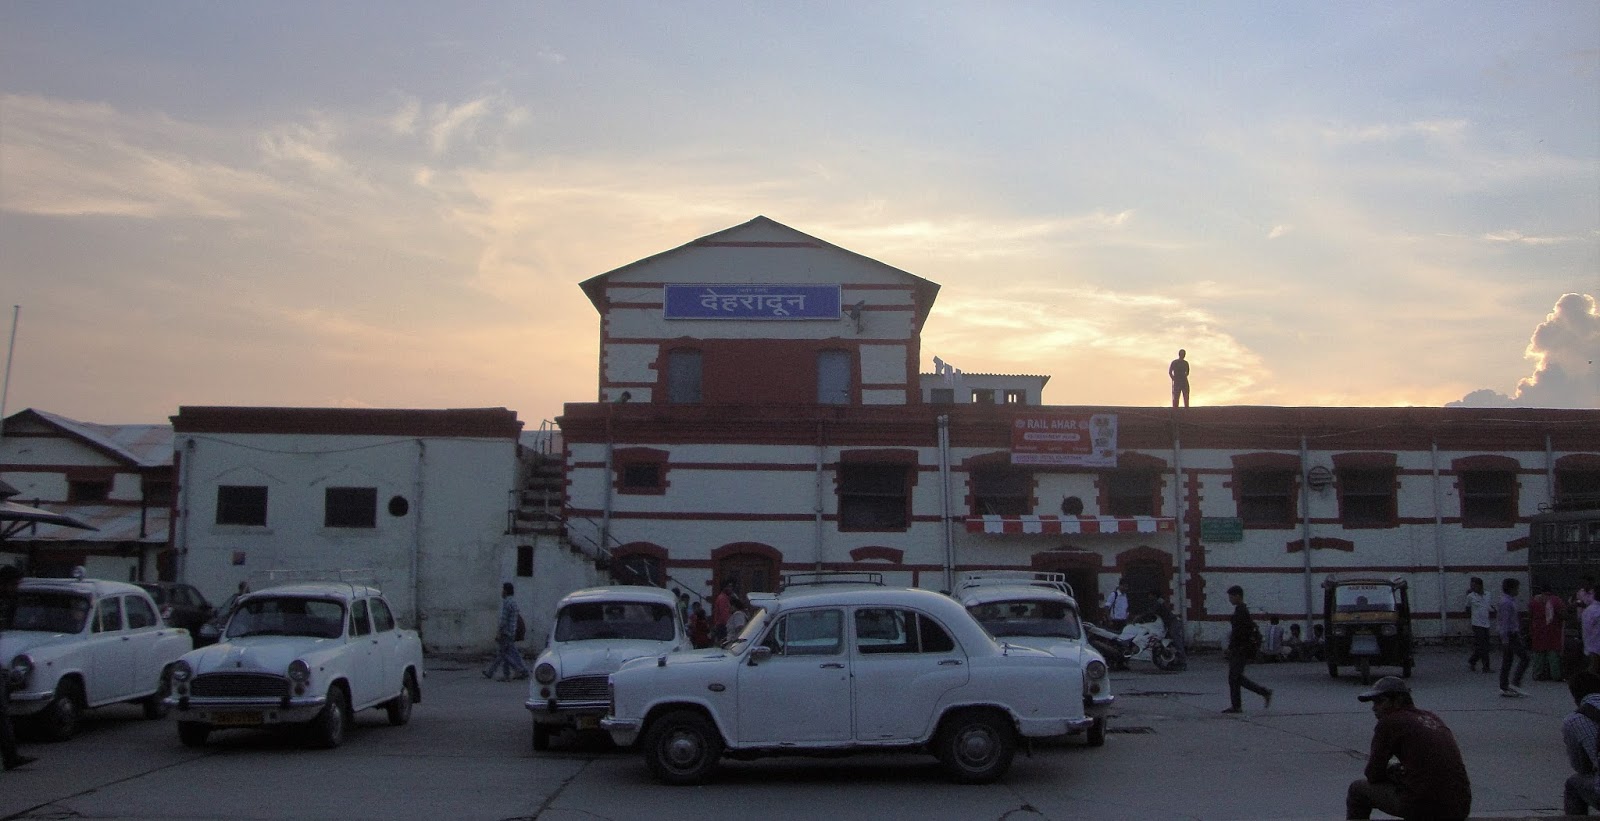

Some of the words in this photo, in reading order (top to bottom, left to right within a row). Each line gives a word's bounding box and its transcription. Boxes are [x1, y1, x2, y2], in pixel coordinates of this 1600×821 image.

[699, 288, 806, 316] देहरादून
[1027, 419, 1048, 429] RAIL
[1051, 419, 1076, 429] AHAR
